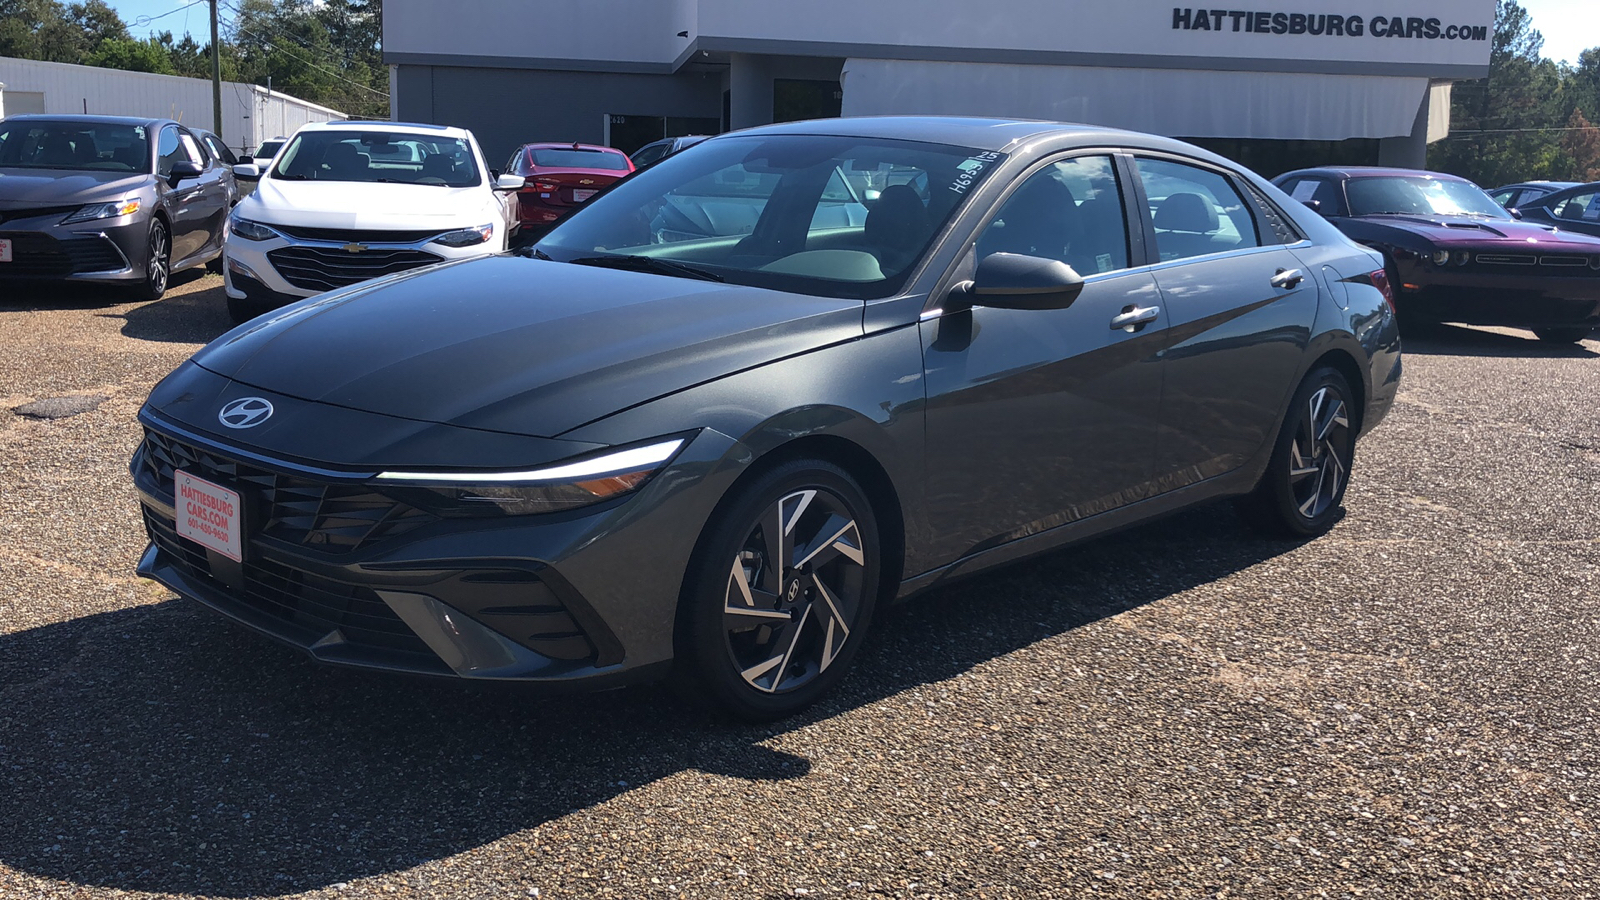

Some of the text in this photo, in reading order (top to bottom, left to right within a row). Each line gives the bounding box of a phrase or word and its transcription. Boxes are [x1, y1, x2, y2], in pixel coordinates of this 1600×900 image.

[1172, 7, 1364, 37] HATTIESBURG
[949, 163, 983, 194] H6953
[181, 483, 234, 518] HATTIESBURG
[187, 501, 229, 531] CARS.COM
[187, 517, 229, 543] 601-450-9630
